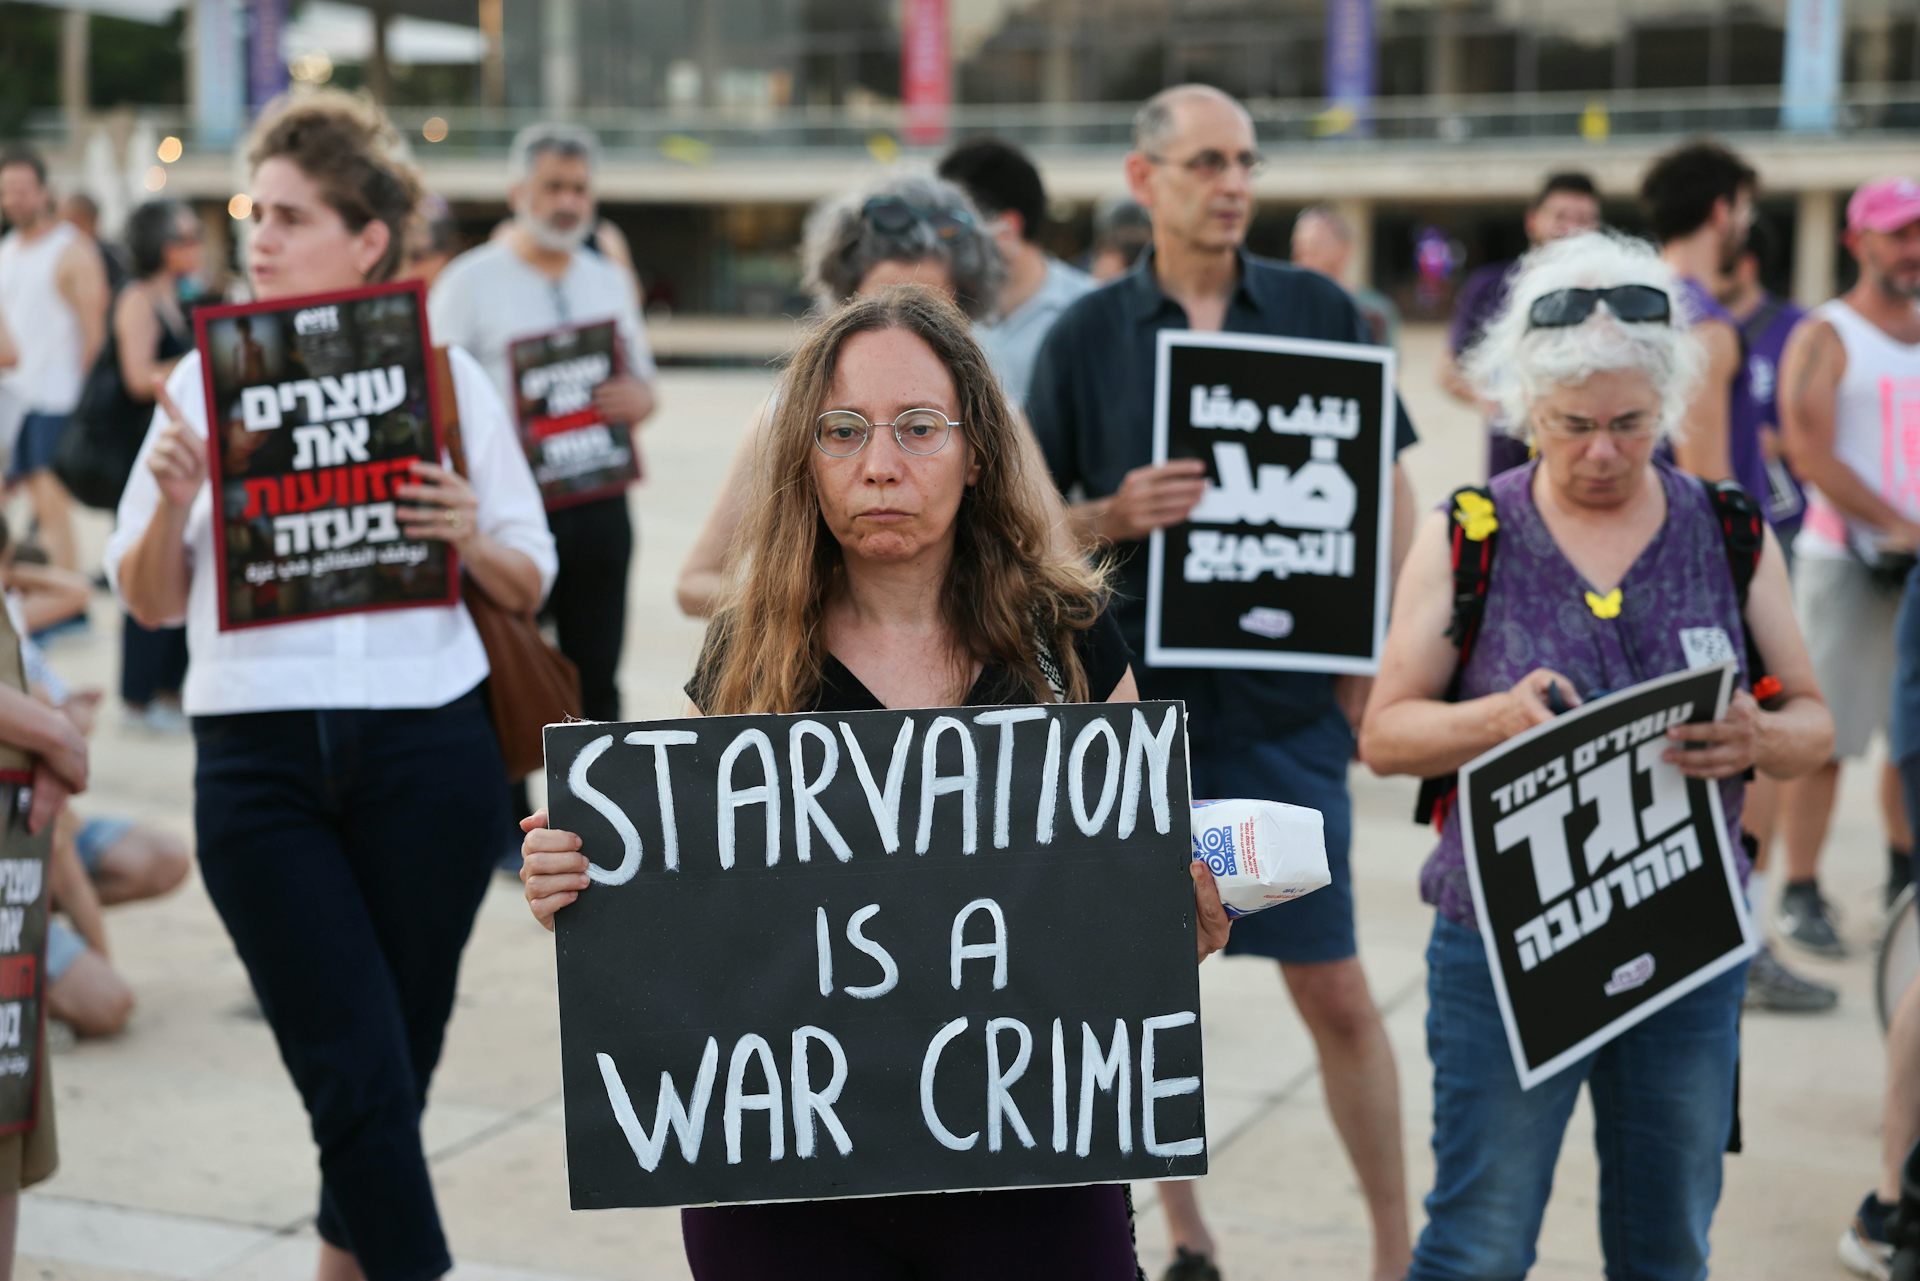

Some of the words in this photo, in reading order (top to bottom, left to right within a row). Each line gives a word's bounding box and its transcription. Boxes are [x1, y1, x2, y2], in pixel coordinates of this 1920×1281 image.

[241, 364, 407, 432] עוצרים
[1267, 394, 1360, 440] نقف
[292, 417, 371, 470] את
[273, 501, 399, 557] בעזה
[1183, 530, 1356, 582] التجويع
[1572, 701, 1694, 774] עומדים
[567, 704, 1178, 887] STARVATION
[1490, 755, 1568, 814] ביחד
[1224, 828, 1233, 854] טחנת
[1494, 734, 1692, 906] נגד
[1227, 856, 1236, 873] רוט
[1514, 823, 1703, 973] ההרעבה
[816, 902, 899, 1000] IS
[950, 897, 1009, 991] A
[596, 1024, 854, 1173] WAR
[919, 1010, 1205, 1157] CRIME
